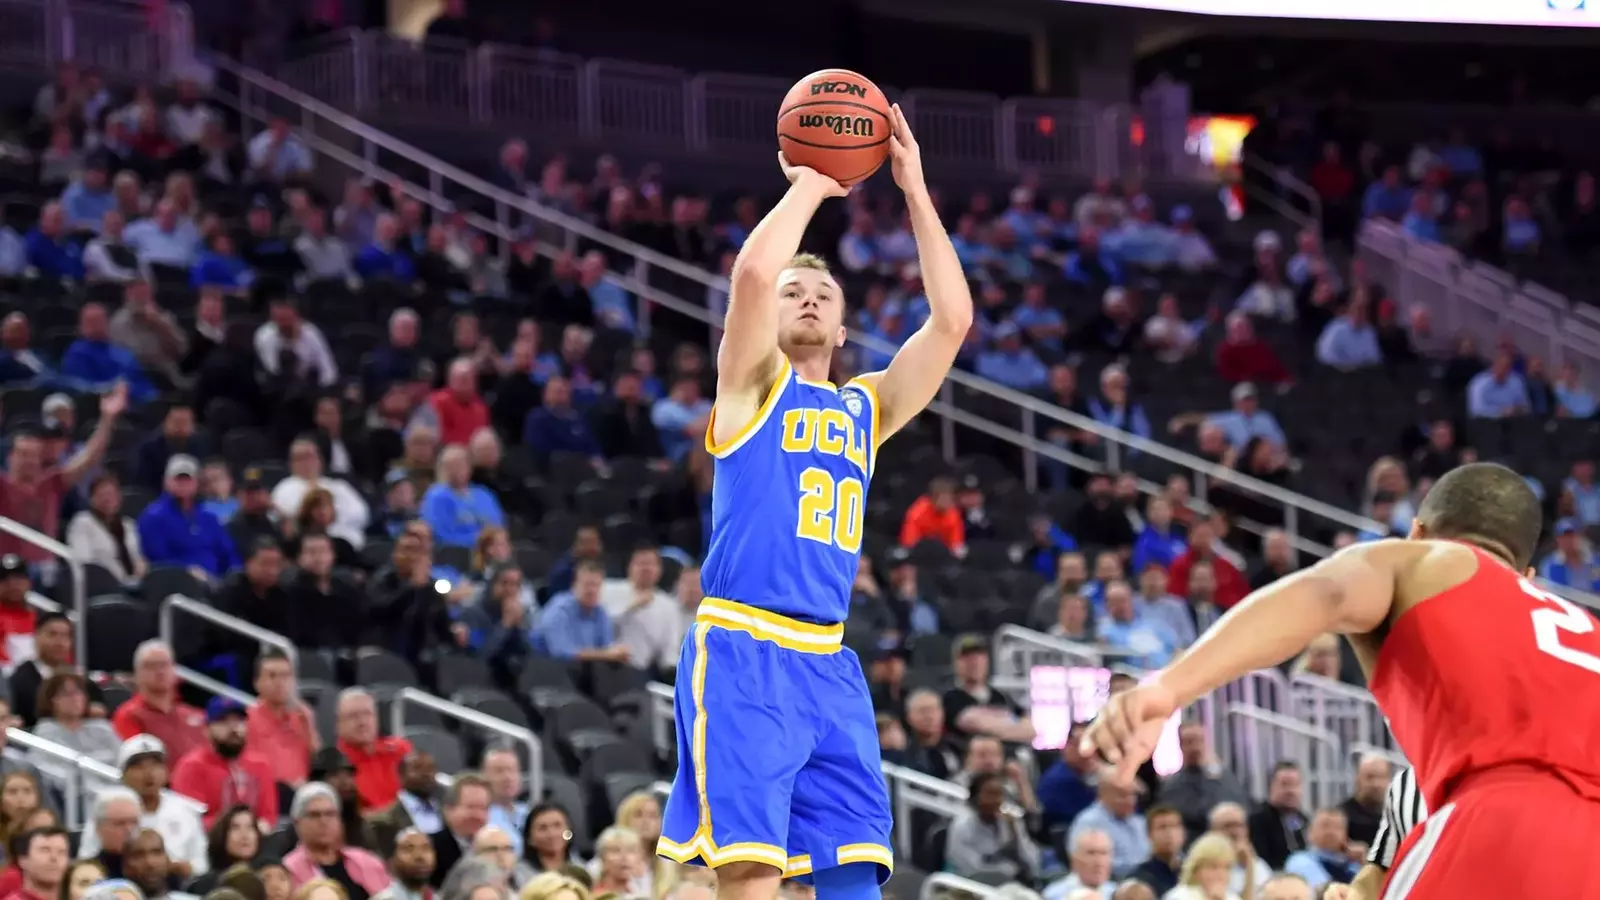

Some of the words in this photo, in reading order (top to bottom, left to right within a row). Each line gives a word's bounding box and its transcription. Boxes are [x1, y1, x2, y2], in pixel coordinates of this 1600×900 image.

[811, 81, 867, 98] NCAA
[799, 114, 874, 136] Wilson
[781, 407, 867, 477] UCL
[796, 466, 863, 554] 20
